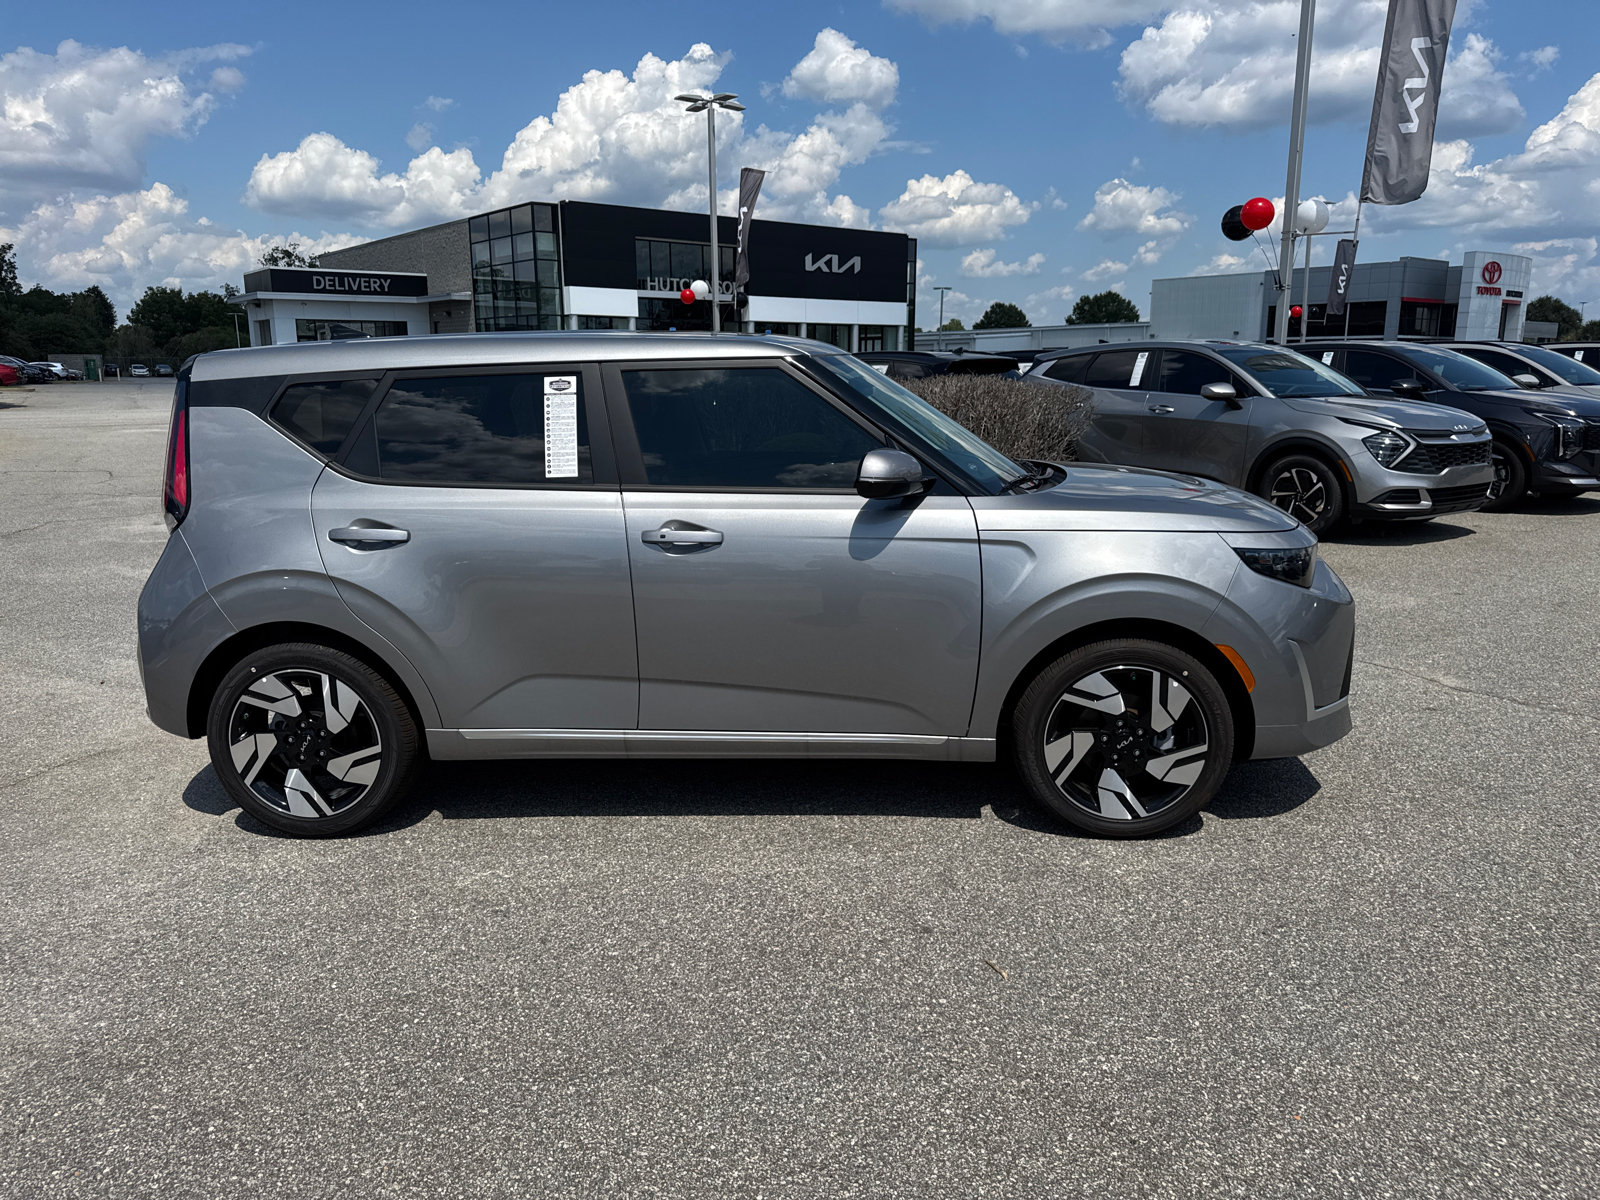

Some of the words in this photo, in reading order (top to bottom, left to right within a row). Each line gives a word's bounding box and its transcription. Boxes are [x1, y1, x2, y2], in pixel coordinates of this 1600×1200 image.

[1398, 37, 1432, 134] KIA
[804, 252, 862, 275] KIA
[312, 275, 391, 292] DELIVERY
[1476, 286, 1502, 296] TOYOTA
